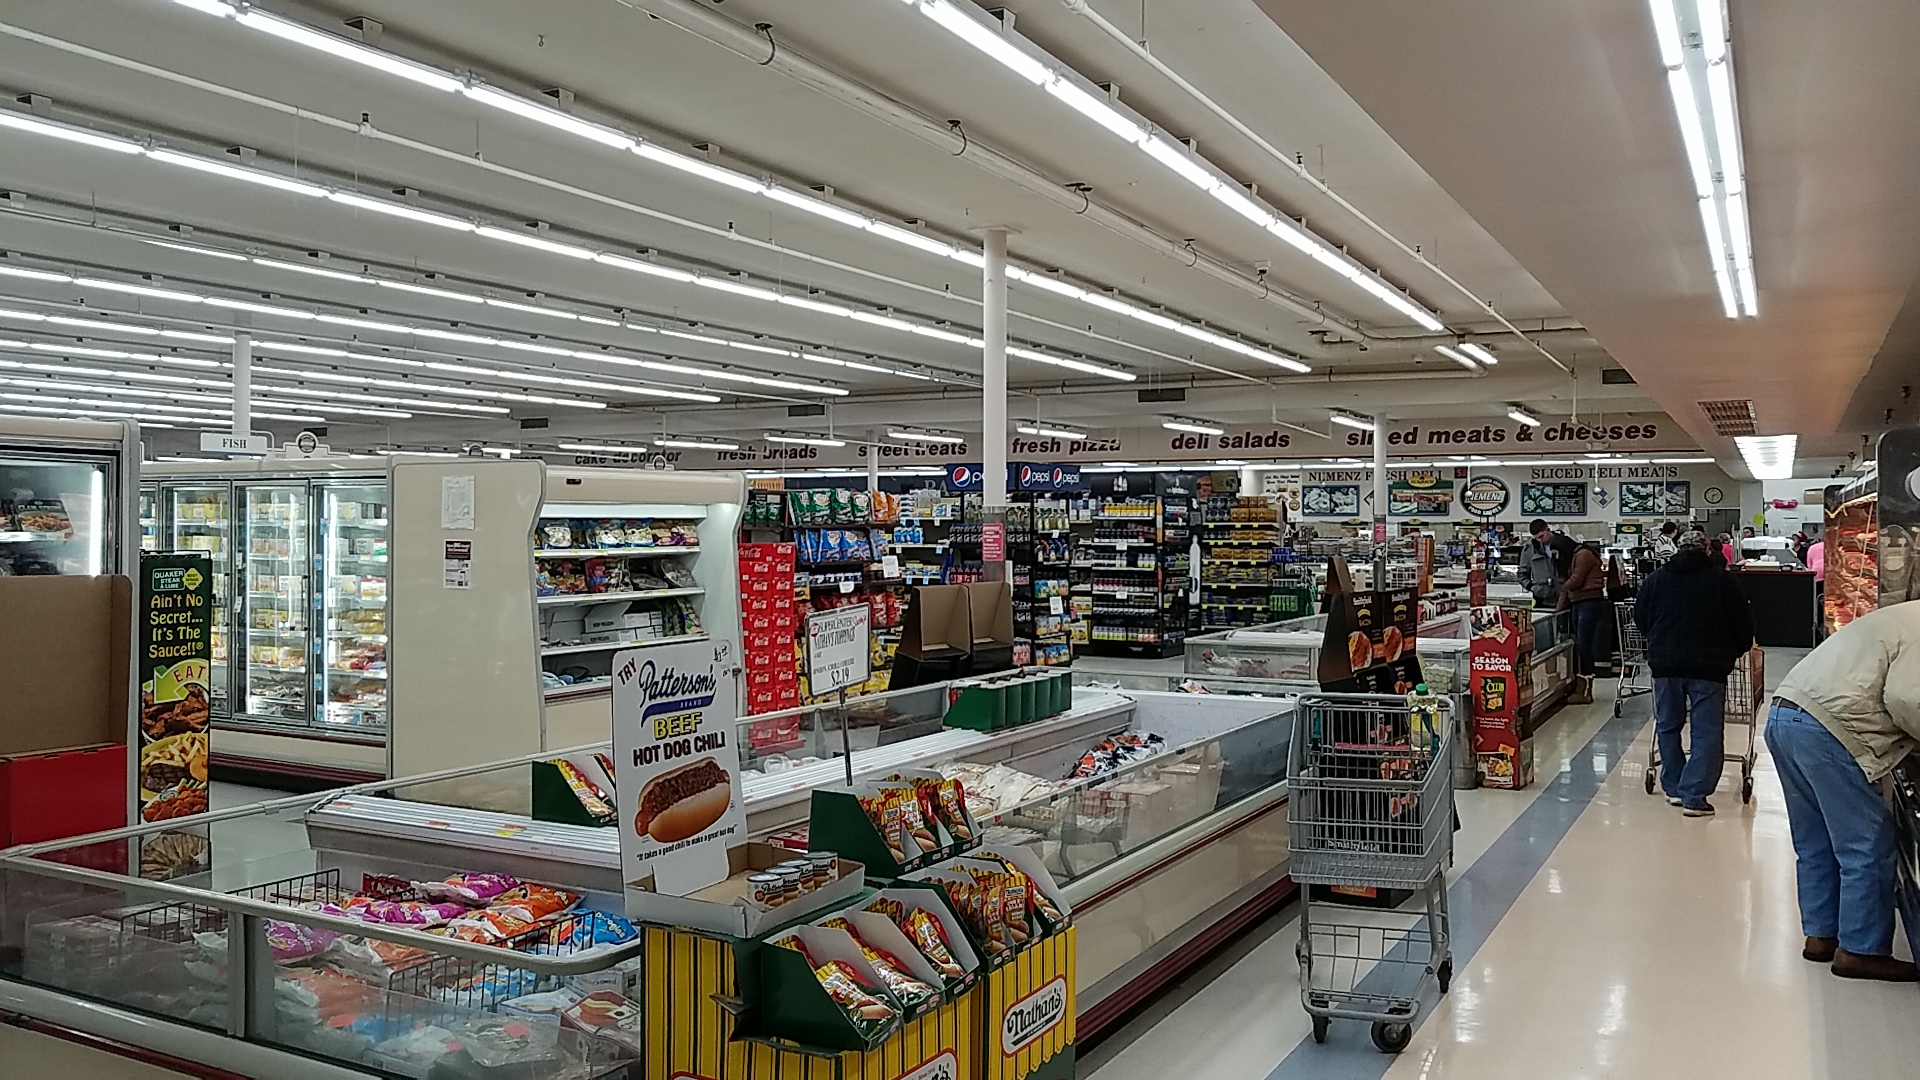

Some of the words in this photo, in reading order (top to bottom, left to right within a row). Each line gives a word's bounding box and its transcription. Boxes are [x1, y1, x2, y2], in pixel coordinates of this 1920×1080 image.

[1170, 433, 1210, 450] deli
[1218, 430, 1291, 449] salads
[1346, 426, 1419, 446] slied
[1427, 425, 1506, 444] meats
[1515, 423, 1533, 442] &
[1543, 422, 1657, 442] cheeses
[222, 438, 247, 449] FISH
[915, 441, 968, 456] treats
[1012, 437, 1061, 454] fresh
[1068, 439, 1121, 456] pizza
[612, 450, 682, 464] decortor
[716, 449, 756, 461] fresh
[762, 445, 818, 460] breads
[1032, 471, 1050, 484] pepsi
[1062, 473, 1080, 485] pepsi
[1308, 471, 1362, 482] NEMENZ
[1365, 470, 1407, 481] FESH
[1532, 467, 1584, 479] SLICED
[1588, 467, 1622, 478] DELI
[1627, 466, 1678, 478] MEATS
[154, 571, 184, 579] QUAKER
[151, 594, 183, 609] Ain't
[185, 593, 204, 607] No
[149, 611, 204, 625] Secret...
[152, 627, 174, 641] It's
[177, 626, 201, 640] The
[1472, 662, 1484, 671] TO
[1485, 664, 1512, 672] SAVOR
[1474, 656, 1508, 665] SEASON
[173, 665, 206, 683] EAT
[617, 657, 638, 686] TRY
[831, 667, 850, 687] $2.19
[638, 659, 718, 708] Patterson's
[680, 699, 703, 709] BRAND
[653, 711, 703, 741] BEEF
[633, 744, 661, 768] HOT
[663, 738, 692, 759] DOG
[693, 731, 726, 754] CHILI
[644, 850, 658, 860] takes
[662, 844, 675, 856] good
[1006, 986, 1063, 1038] Nathan's
